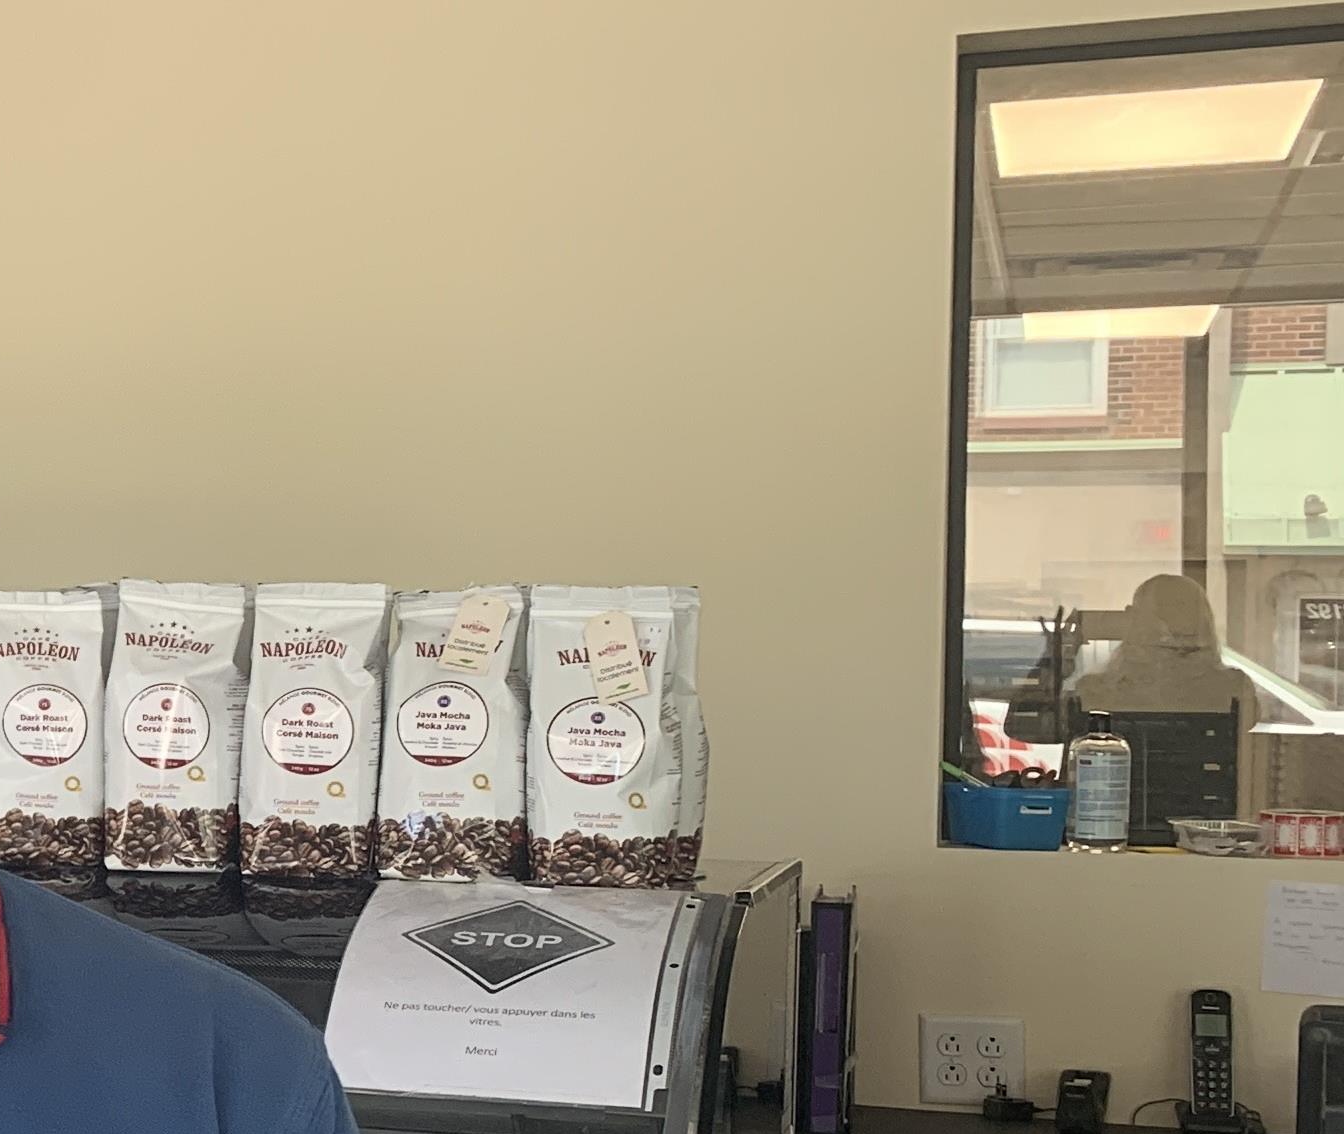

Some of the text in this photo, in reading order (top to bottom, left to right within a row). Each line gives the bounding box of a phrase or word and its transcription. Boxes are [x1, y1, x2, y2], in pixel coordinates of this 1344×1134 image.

[124, 632, 215, 654] NAPOLÉON
[260, 637, 347, 659] NAPOLÉON
[142, 714, 163, 722] Dark
[416, 711, 471, 720] Java Mocha
[281, 718, 334, 728] Dark Roast
[416, 722, 467, 731] Moka Java
[165, 726, 197, 735] aison
[276, 729, 339, 740] Corsé Maison
[593, 728, 626, 737] Mocha
[598, 740, 622, 748] Java
[451, 930, 563, 949] STOP
[384, 1001, 596, 1019] Ne pas toucher/ vous appuyer dans les
[465, 1046, 497, 1056] Merci
